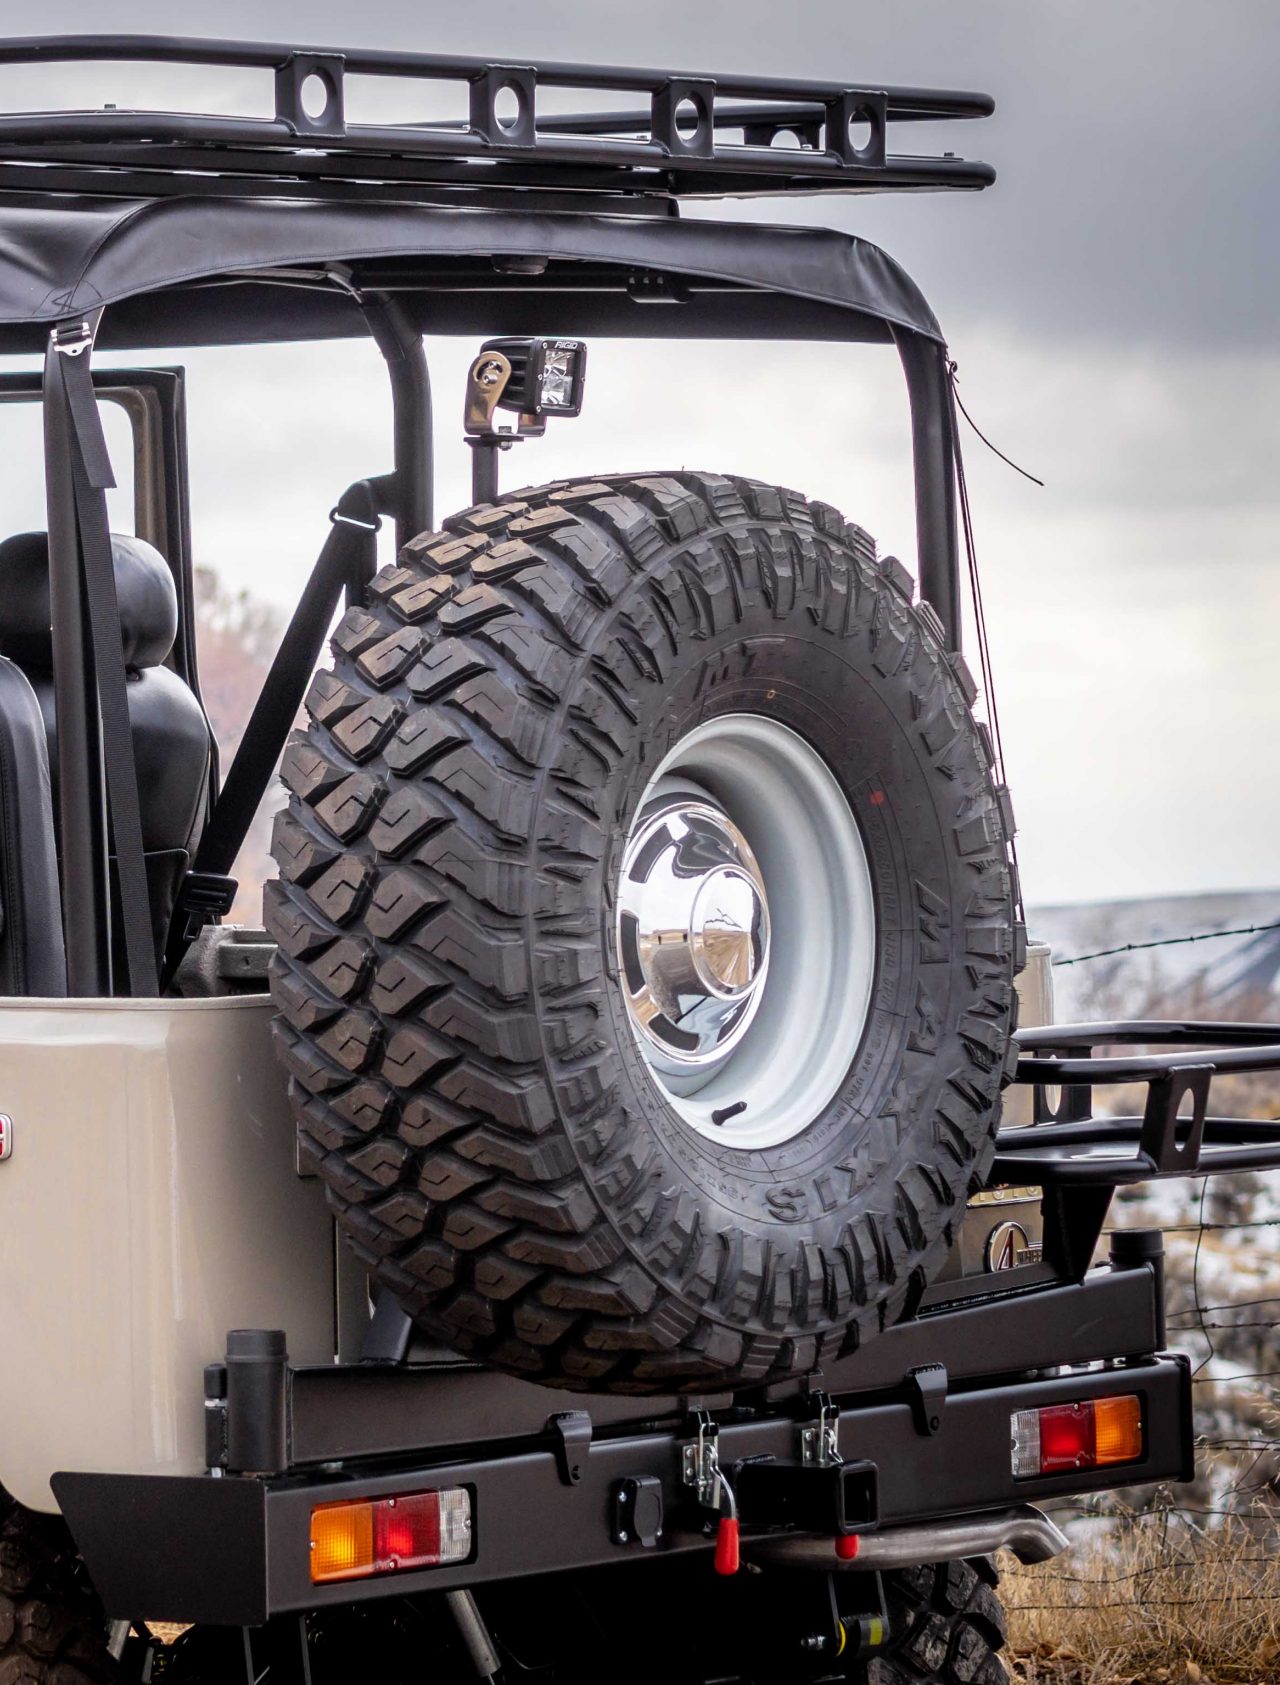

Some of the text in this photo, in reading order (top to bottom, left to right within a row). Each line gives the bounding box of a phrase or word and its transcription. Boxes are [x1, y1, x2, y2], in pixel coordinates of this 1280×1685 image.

[554, 341, 578, 349] RIGID
[765, 880, 949, 1222] MAXXIS
[1018, 1250, 1042, 1265] WHEE
